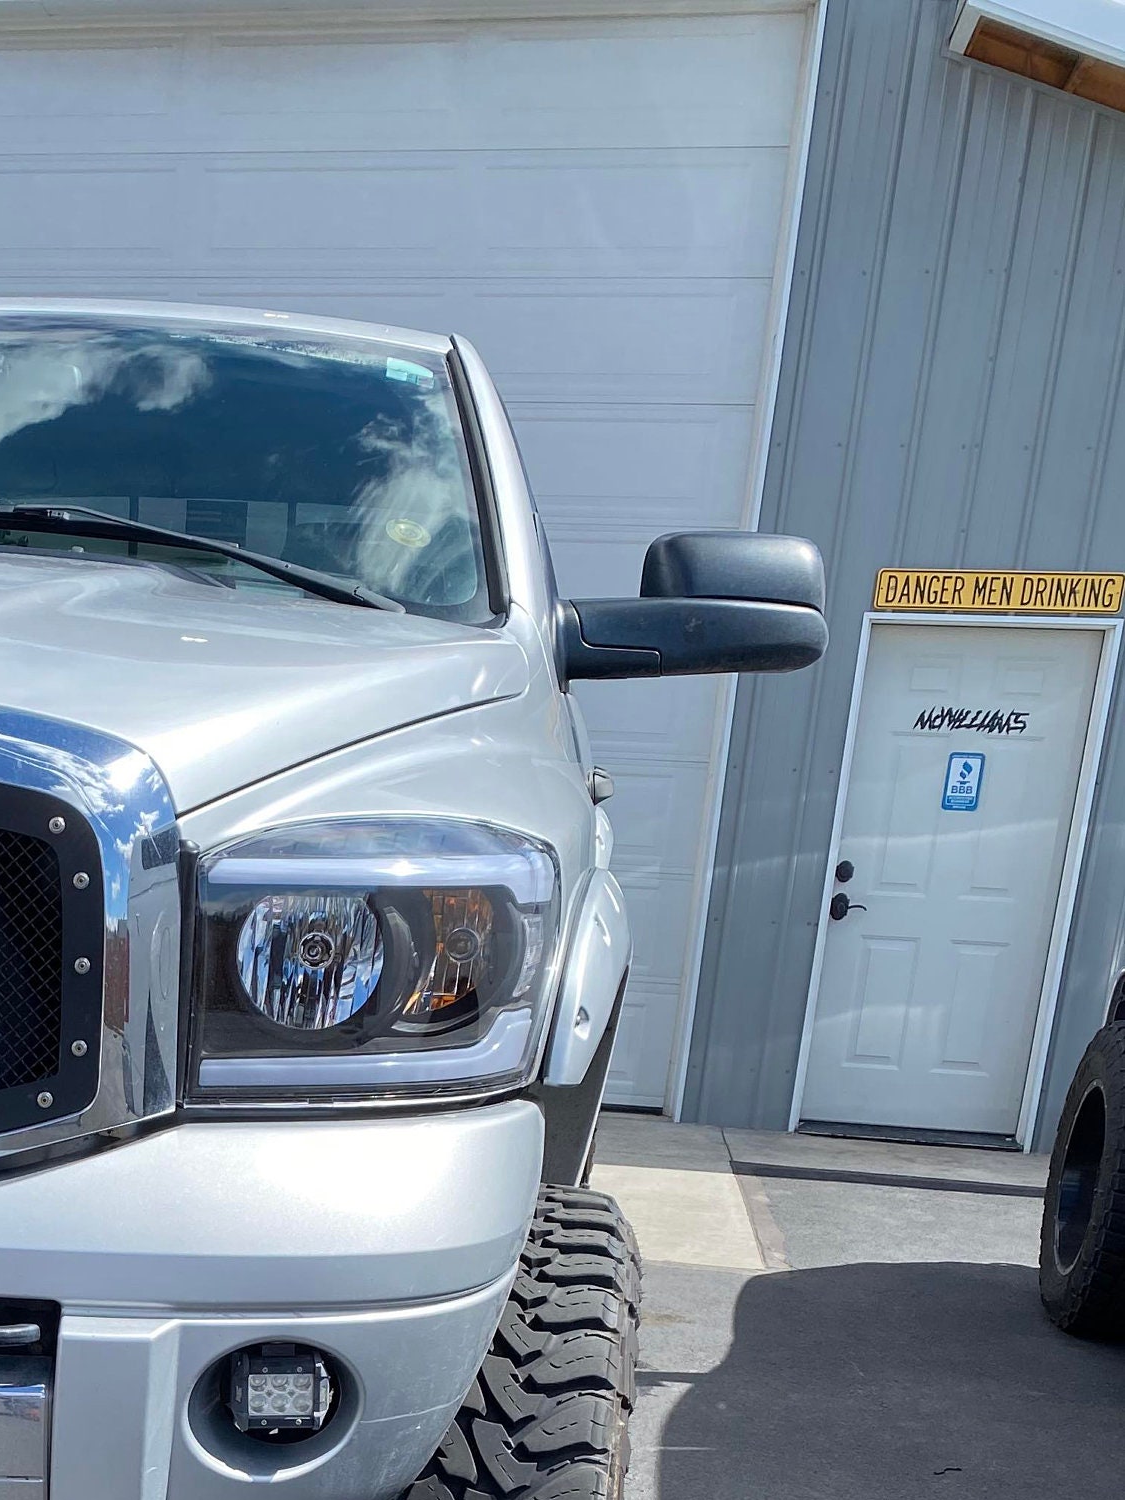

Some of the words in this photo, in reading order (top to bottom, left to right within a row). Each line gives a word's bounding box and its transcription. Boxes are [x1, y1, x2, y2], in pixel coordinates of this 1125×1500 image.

[884, 574, 965, 605] DANGER
[971, 576, 1015, 606] MEN
[1020, 577, 1116, 608] DRINKING
[951, 785, 973, 794] BBB
